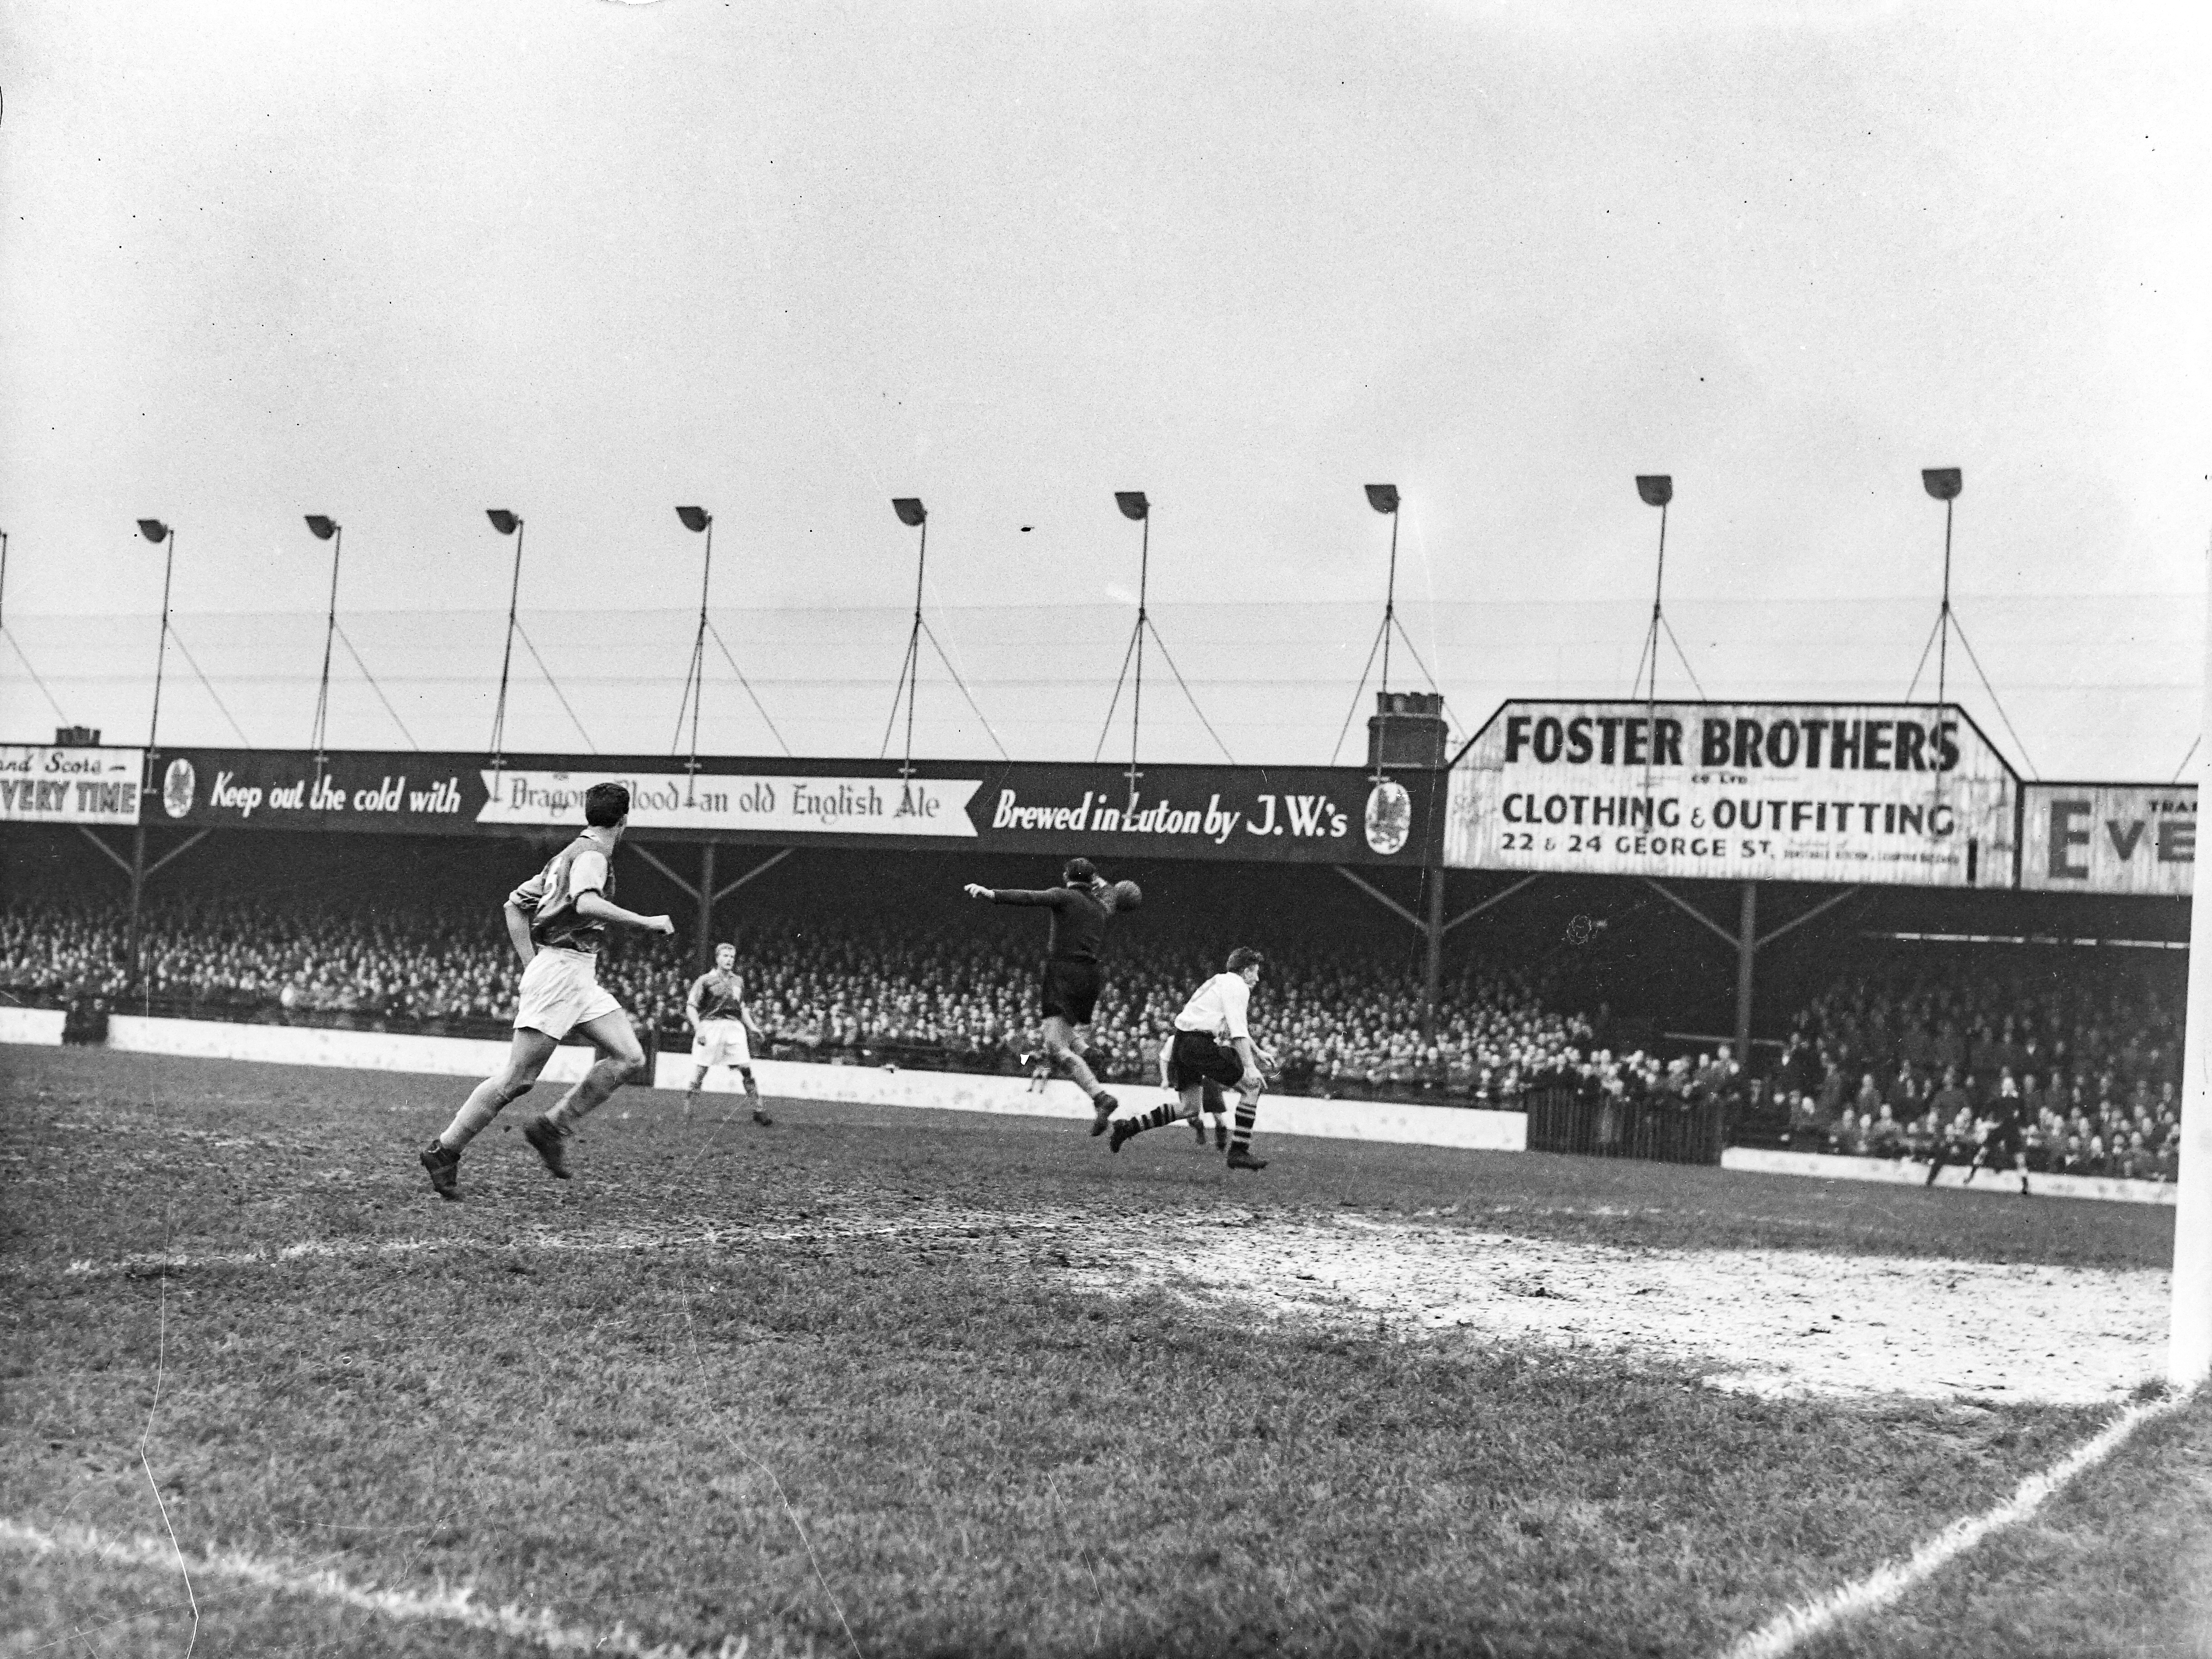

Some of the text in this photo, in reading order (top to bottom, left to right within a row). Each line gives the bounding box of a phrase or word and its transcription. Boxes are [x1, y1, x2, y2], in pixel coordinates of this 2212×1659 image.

[1504, 716, 1960, 772] FOSTER BROTHERS
[76, 782, 137, 814] TIME
[211, 770, 461, 818] Keep out the cold with
[616, 779, 679, 811] lood
[699, 793, 728, 812] an
[739, 782, 776, 813] old
[793, 783, 883, 824] English
[893, 784, 940, 818] Ale
[1502, 794, 1681, 827] CLOTHING
[1713, 799, 1955, 835] OUTFITTING
[992, 789, 1094, 830] Brewed
[1091, 794, 1120, 831] in
[1121, 791, 1202, 834] Luton
[1203, 794, 1241, 845] by
[1501, 833, 1533, 851] 22
[1569, 835, 1601, 852] 24
[1615, 836, 1727, 857] GEORGE
